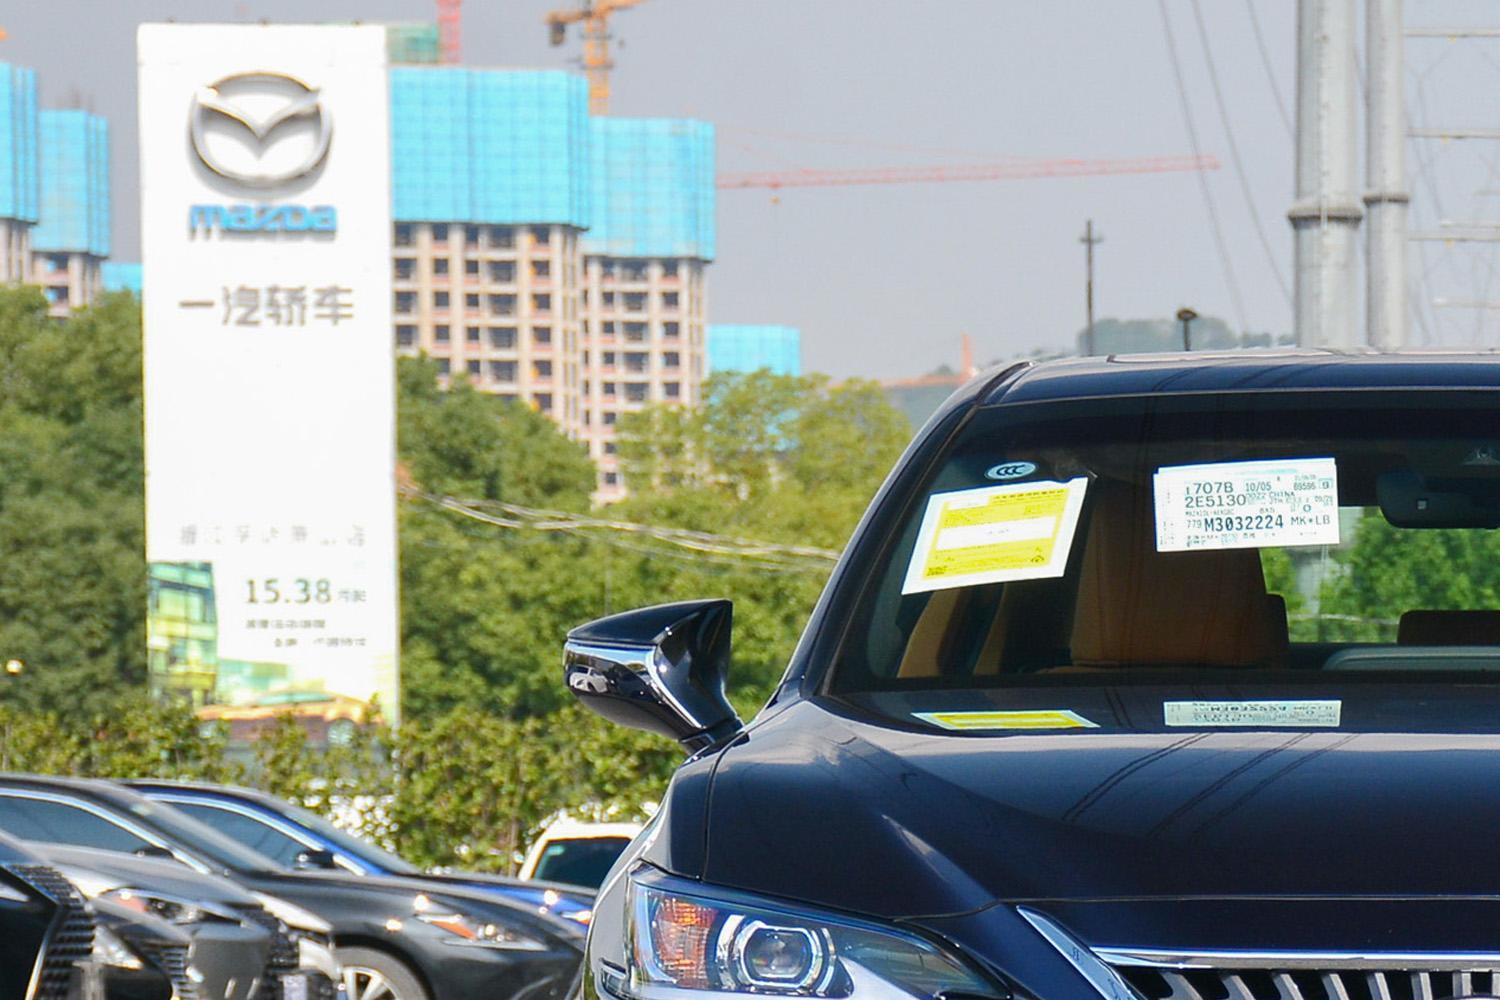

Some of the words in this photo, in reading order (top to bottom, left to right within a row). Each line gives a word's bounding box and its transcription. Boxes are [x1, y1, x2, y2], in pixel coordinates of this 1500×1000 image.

[178, 285, 354, 327] 一汽轿车
[1184, 493, 1247, 509] 2E5130
[1204, 514, 1284, 532] M3032224
[245, 577, 332, 604] 15.38
